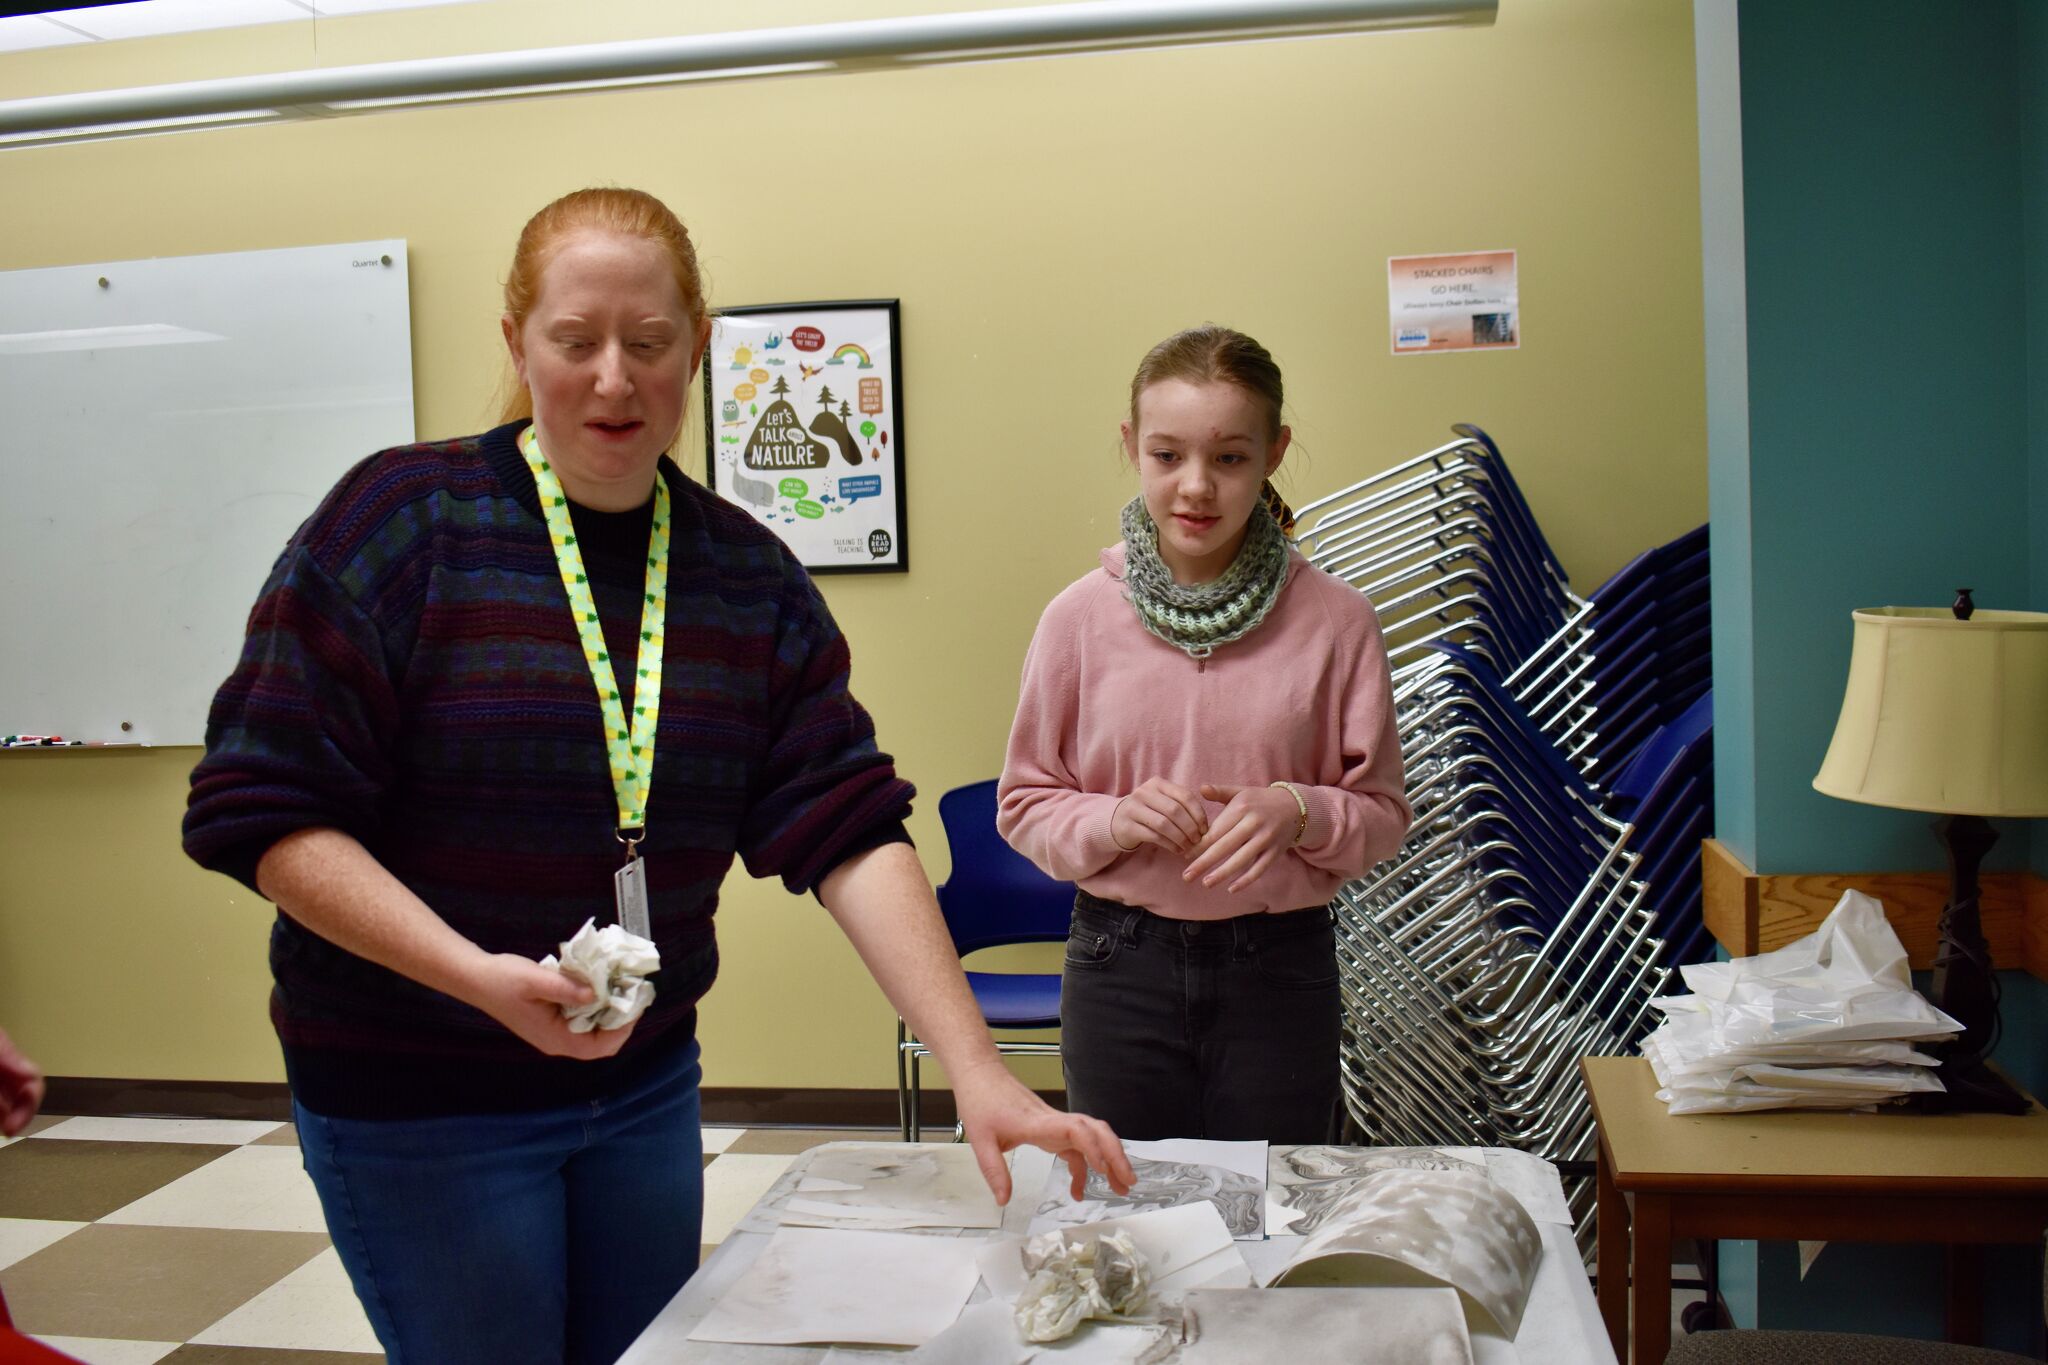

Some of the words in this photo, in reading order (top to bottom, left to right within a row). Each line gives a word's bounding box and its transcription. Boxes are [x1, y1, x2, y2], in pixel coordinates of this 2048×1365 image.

[1414, 267, 1457, 279] STACKED
[1458, 265, 1494, 276] CHAIRS
[1431, 285, 1447, 295] GO
[759, 427, 787, 443] TALK
[833, 537, 855, 546] TALKING
[871, 533, 888, 541] TALK
